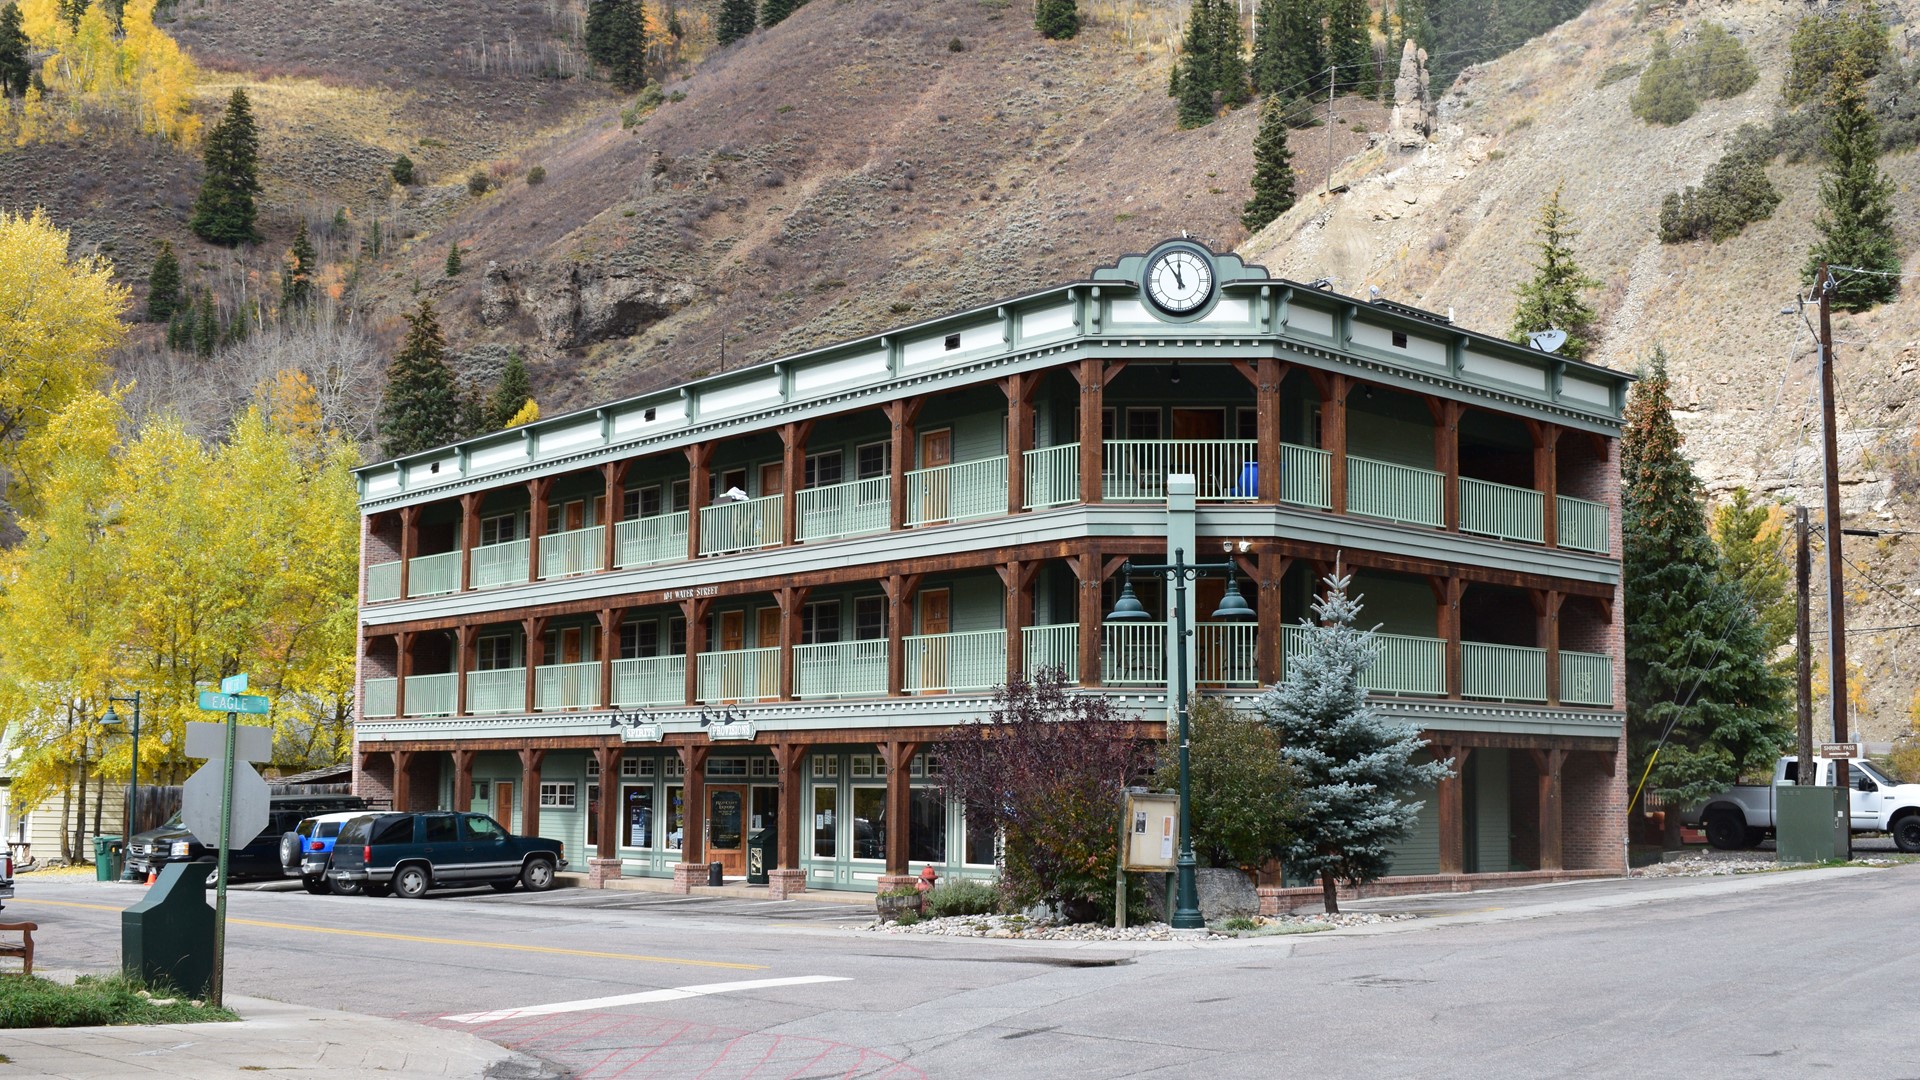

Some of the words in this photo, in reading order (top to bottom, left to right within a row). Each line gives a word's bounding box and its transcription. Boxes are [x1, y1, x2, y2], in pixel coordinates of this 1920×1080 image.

[675, 589, 694, 599] WATER
[696, 586, 719, 597] STREET
[212, 696, 248, 711] EAGLE
[626, 727, 656, 738] SPIRITS
[711, 725, 751, 737] PROVISIONS
